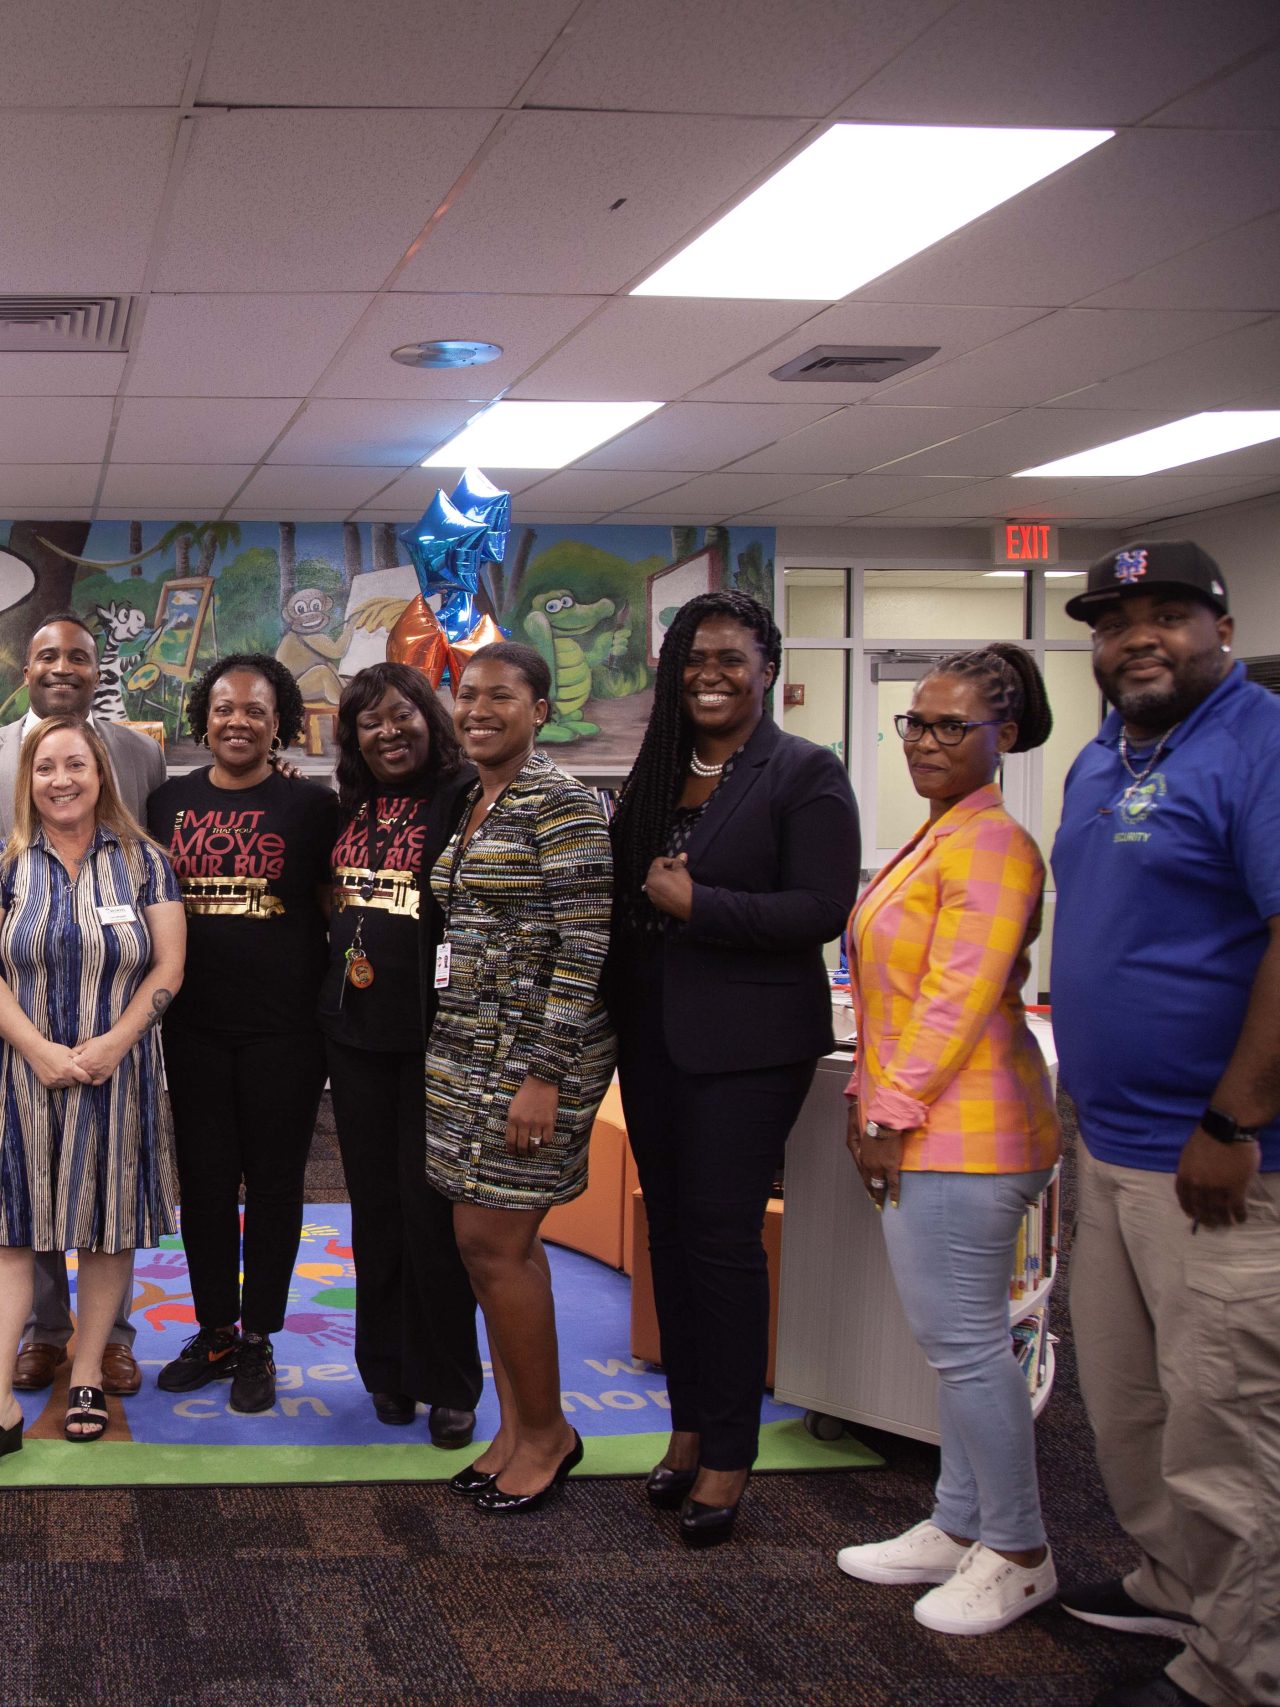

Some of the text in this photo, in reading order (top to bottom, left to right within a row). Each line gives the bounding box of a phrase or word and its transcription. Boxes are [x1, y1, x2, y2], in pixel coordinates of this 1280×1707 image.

[1006, 525, 1050, 560] EXIT
[182, 809, 265, 830] MUST
[234, 854, 285, 880] BUS
